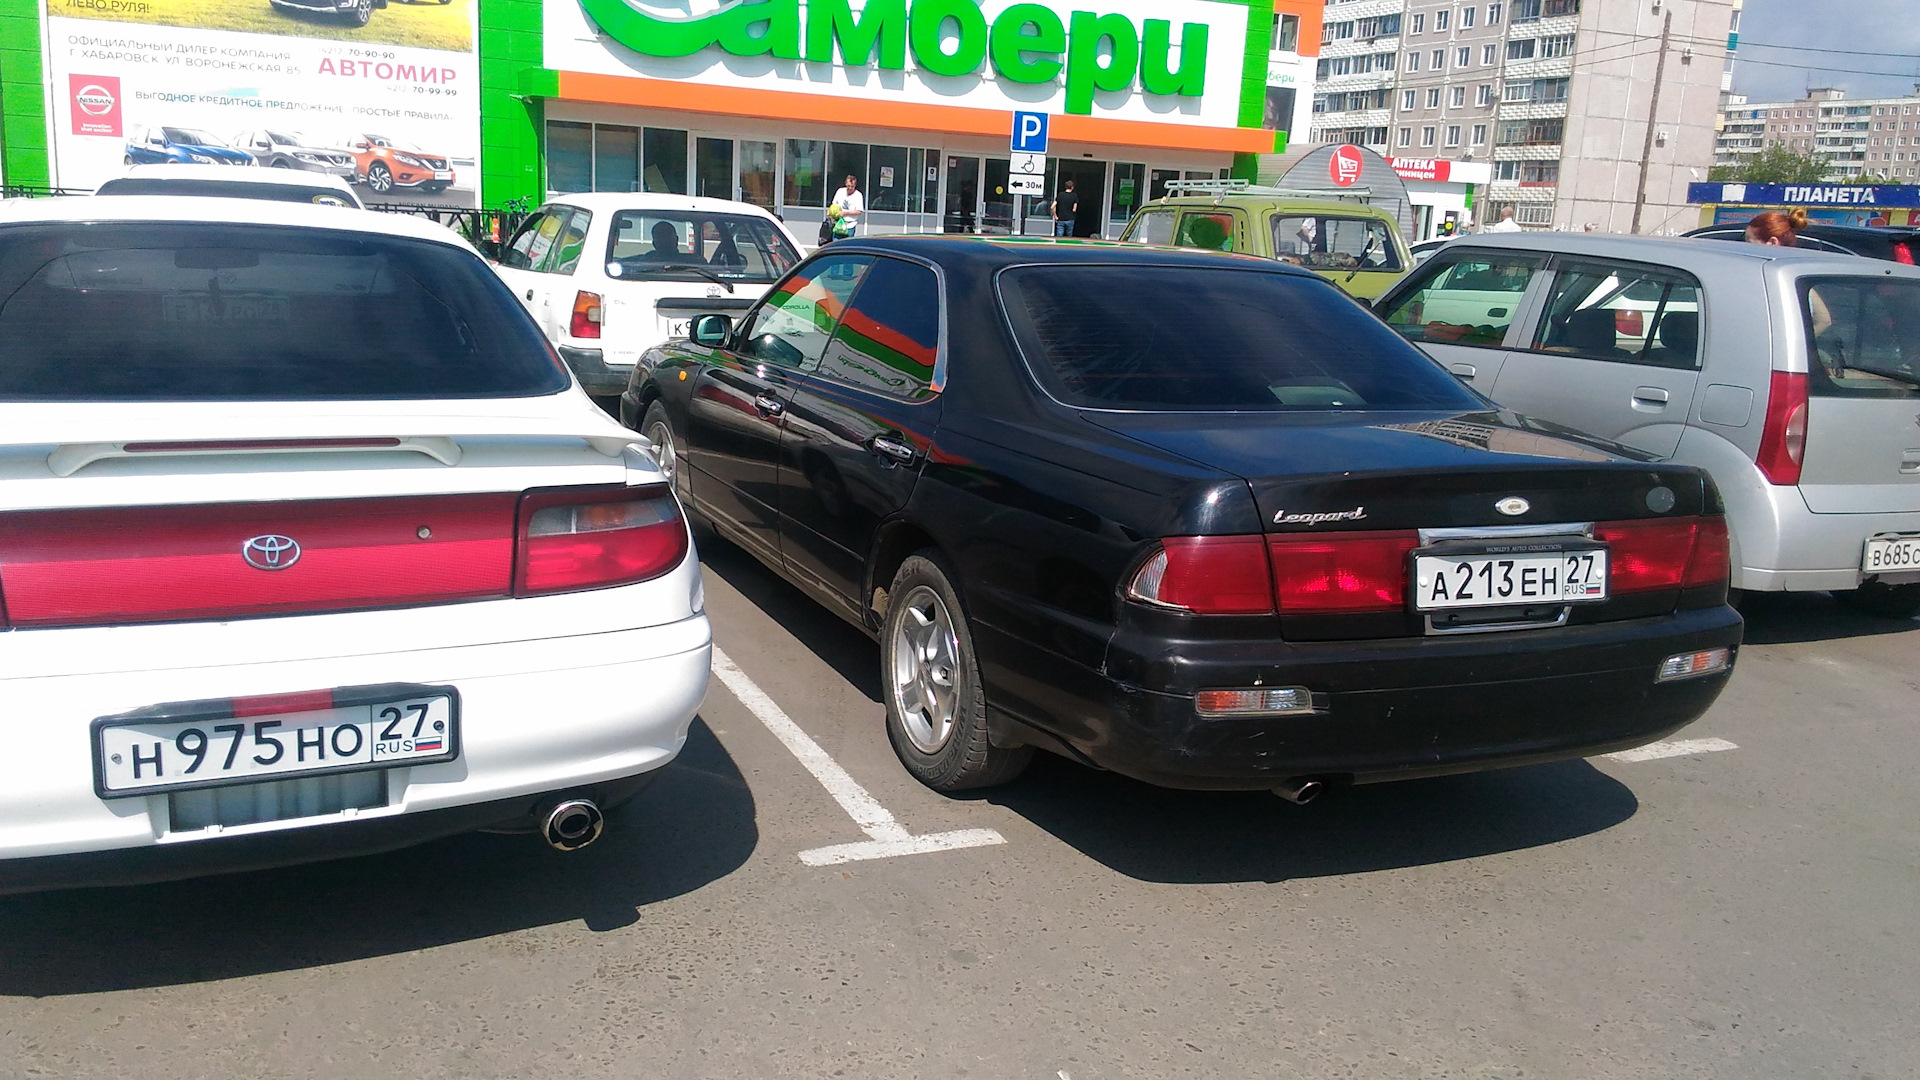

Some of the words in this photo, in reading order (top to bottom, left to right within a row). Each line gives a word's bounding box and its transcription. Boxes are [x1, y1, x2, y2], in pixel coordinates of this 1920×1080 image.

[176, 43, 217, 54] ДИЛЕР
[220, 48, 291, 60] КОМПАНИЯ
[348, 49, 395, 60] 70-90-90
[82, 50, 158, 63] ХАБАРОВСК
[185, 58, 281, 72] ВОРОНЕЖСКАЯ
[318, 57, 457, 84] АВТОМИР
[413, 86, 457, 96] 70-99-99
[79, 97, 112, 105] NISSAN
[135, 91, 197, 103] ВЫГОДНОЕ
[199, 95, 263, 108] КРЕДИТНОЕ
[266, 100, 343, 113] ПРЕДЛОЖЕНИЕ
[353, 106, 401, 117] ПРОСТЫЕ
[1020, 115, 1042, 148] P
[1391, 157, 1436, 171] АПТЕКА
[1783, 186, 1876, 204] ПЛАНЕТА
[1273, 506, 1368, 526] Leopard
[1528, 543, 1562, 551] COLLECTION
[1567, 555, 1594, 584] 27
[1564, 584, 1585, 595] RUS
[379, 704, 429, 741] 27
[375, 740, 413, 756] RUS
